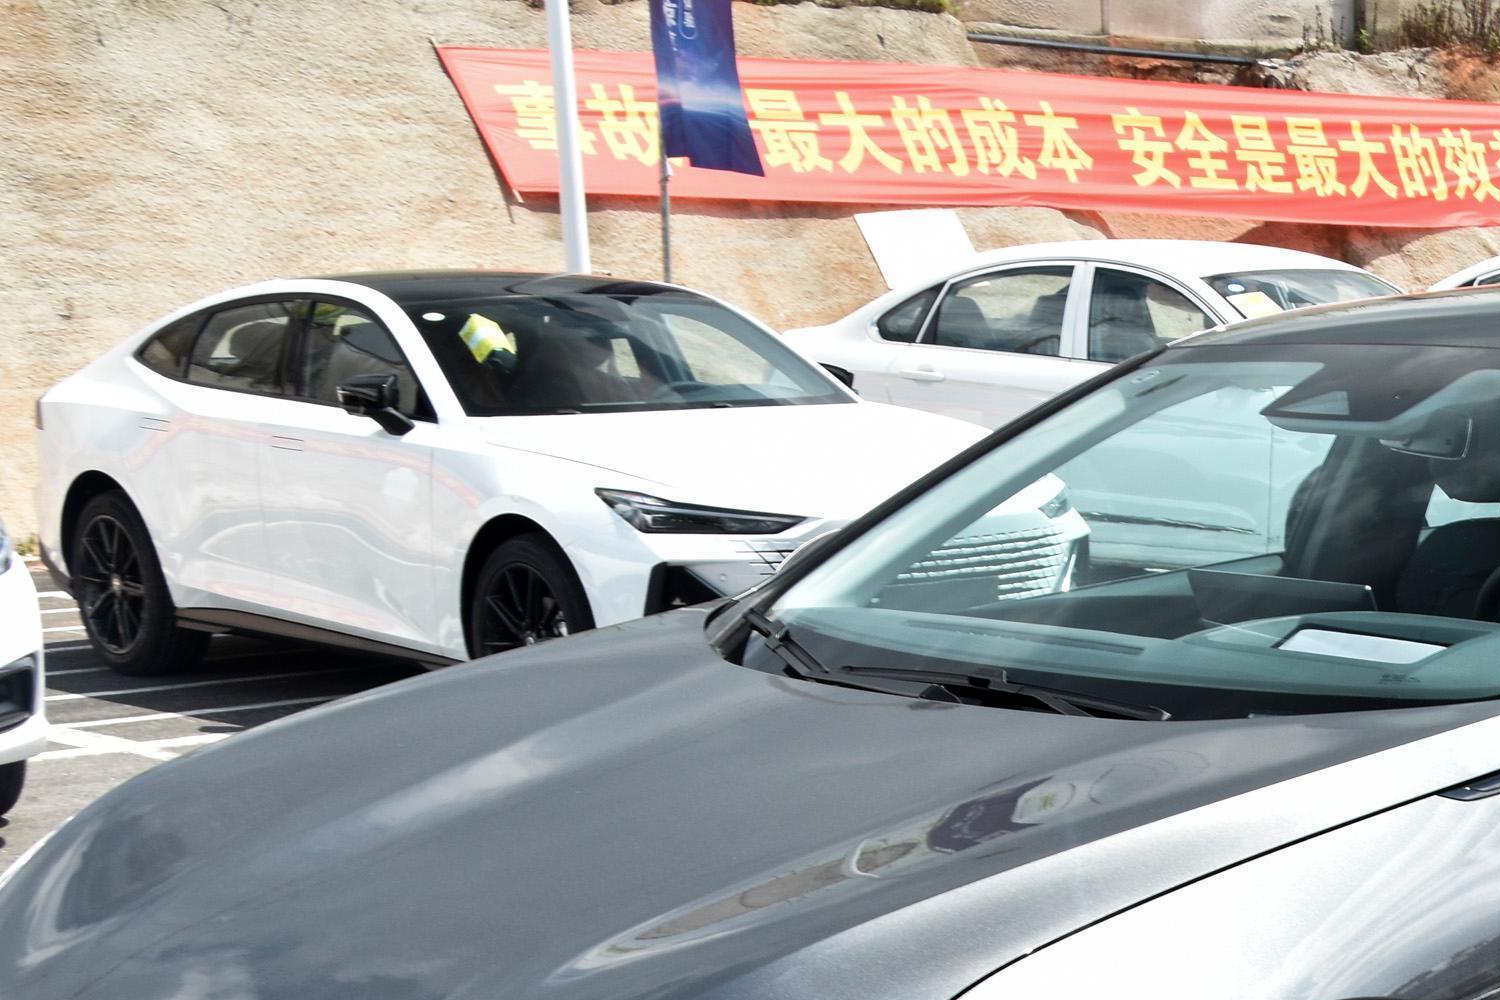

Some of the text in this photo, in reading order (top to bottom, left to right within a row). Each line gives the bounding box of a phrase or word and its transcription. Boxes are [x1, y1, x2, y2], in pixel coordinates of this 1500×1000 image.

[495, 80, 1095, 184] 事故最大的成本
